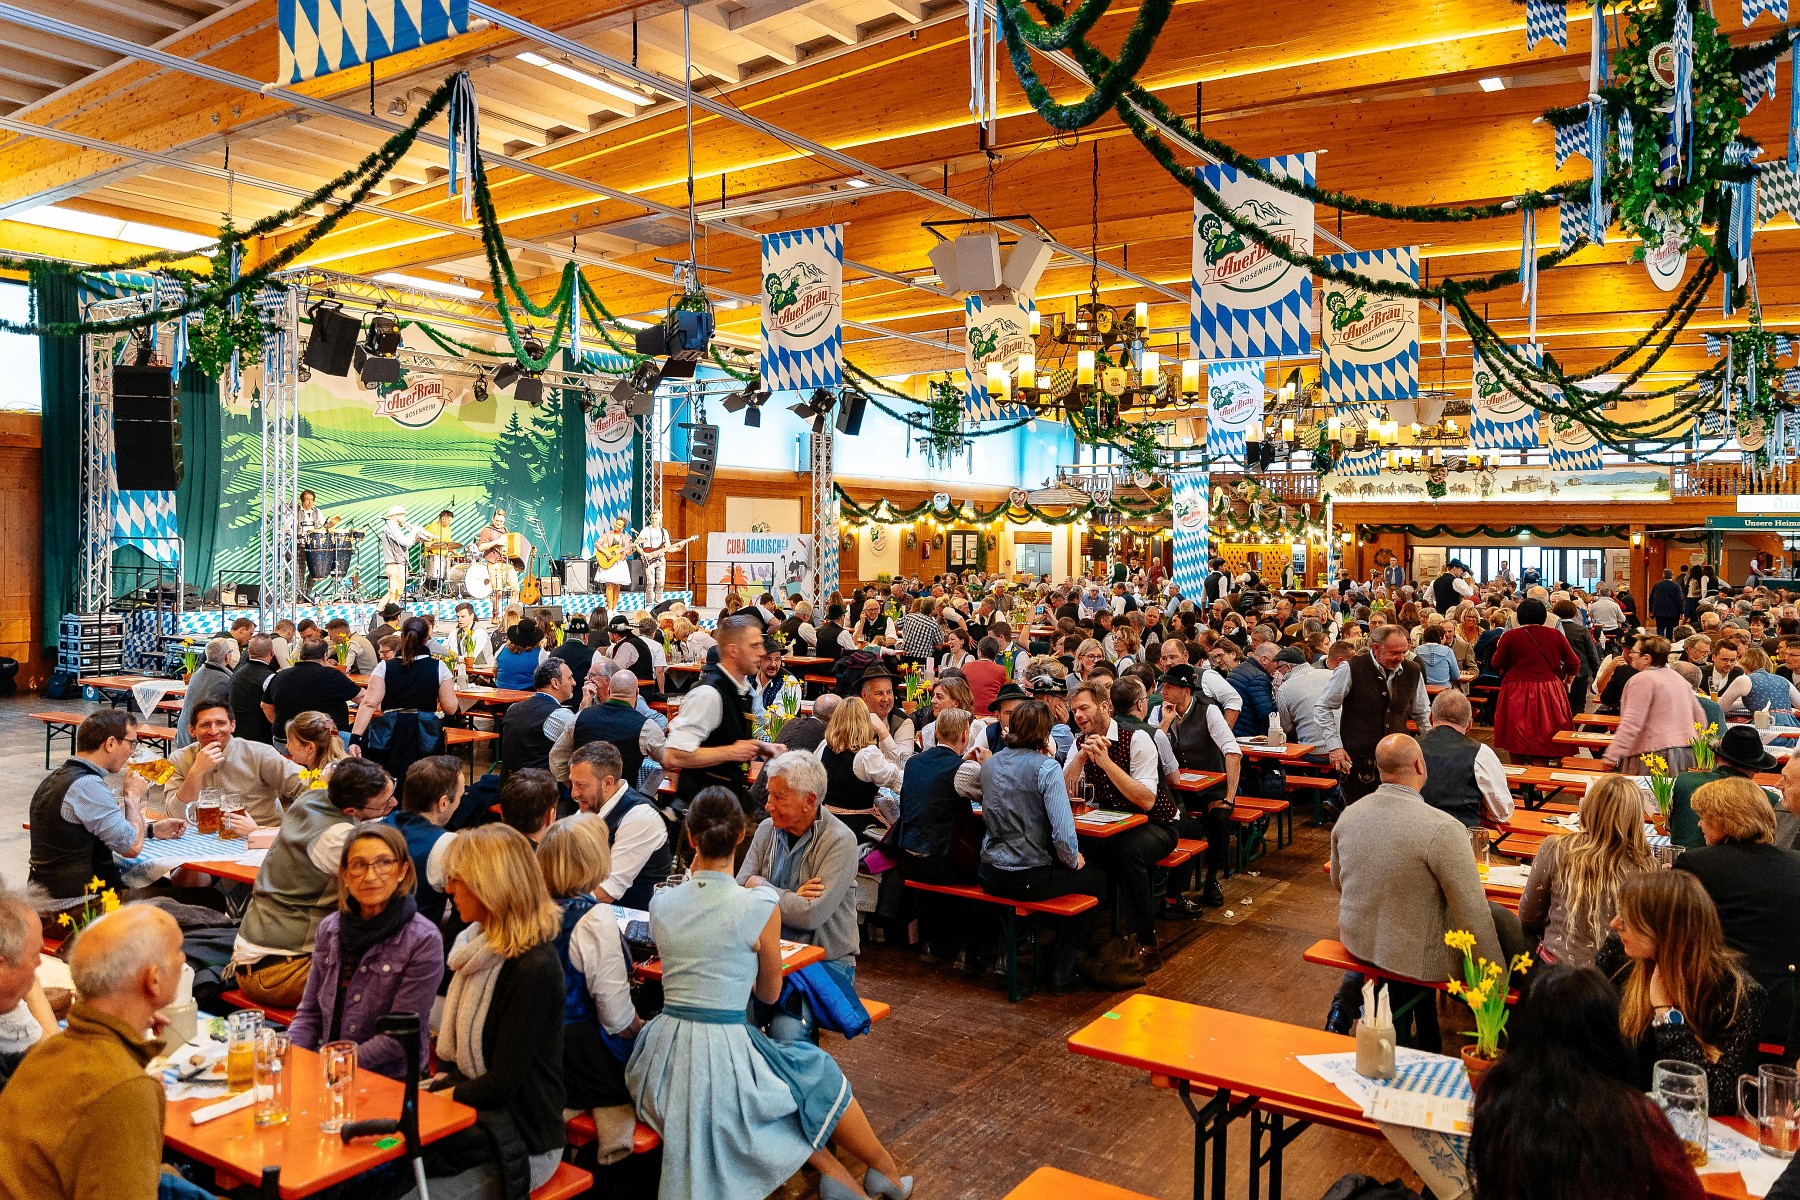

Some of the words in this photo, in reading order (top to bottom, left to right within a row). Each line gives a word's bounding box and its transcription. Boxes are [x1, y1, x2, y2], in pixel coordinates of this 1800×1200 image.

[1240, 260, 1283, 285] ROSENHEIM
[779, 290, 827, 325] AuerBräu
[1342, 307, 1401, 341] AuerBräu
[1360, 326, 1395, 346] ROSENHEIM
[387, 381, 441, 411] AuerBräu
[1744, 519, 1773, 527] Unsere
[727, 538, 781, 555] CUBABOARISCH
